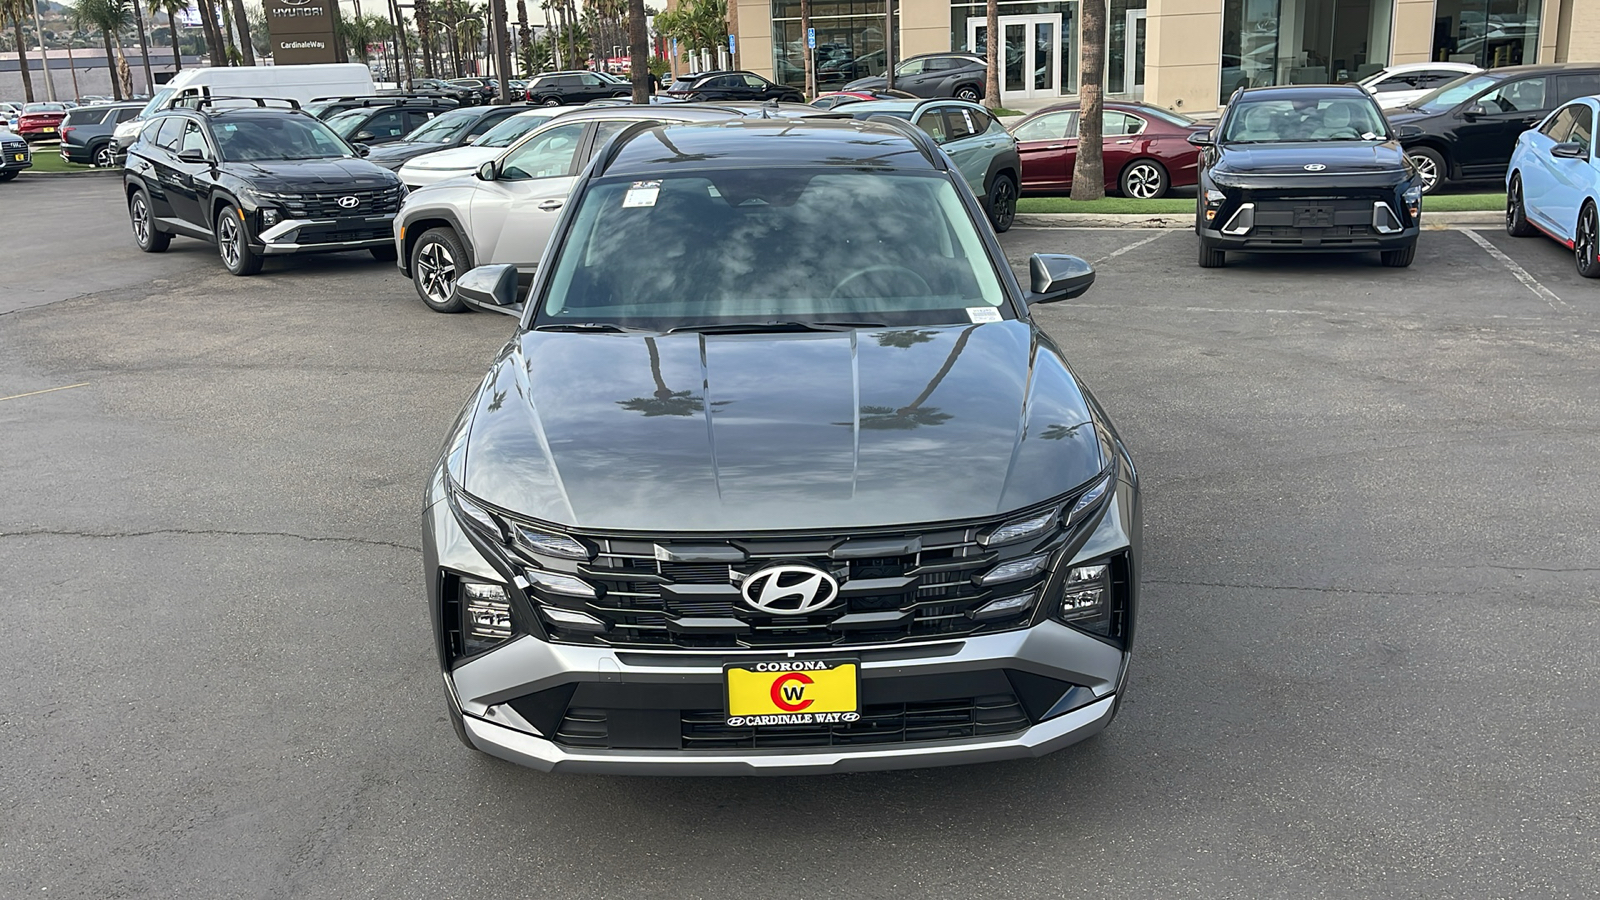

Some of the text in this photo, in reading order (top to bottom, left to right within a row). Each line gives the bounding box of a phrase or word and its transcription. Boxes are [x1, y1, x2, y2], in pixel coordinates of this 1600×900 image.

[272, 7, 323, 17] HYUNDAI
[280, 41, 325, 49] CardinaleWay
[756, 661, 827, 672] CORONA
[783, 685, 805, 701] W
[746, 713, 841, 726] CARDINALE WAY
